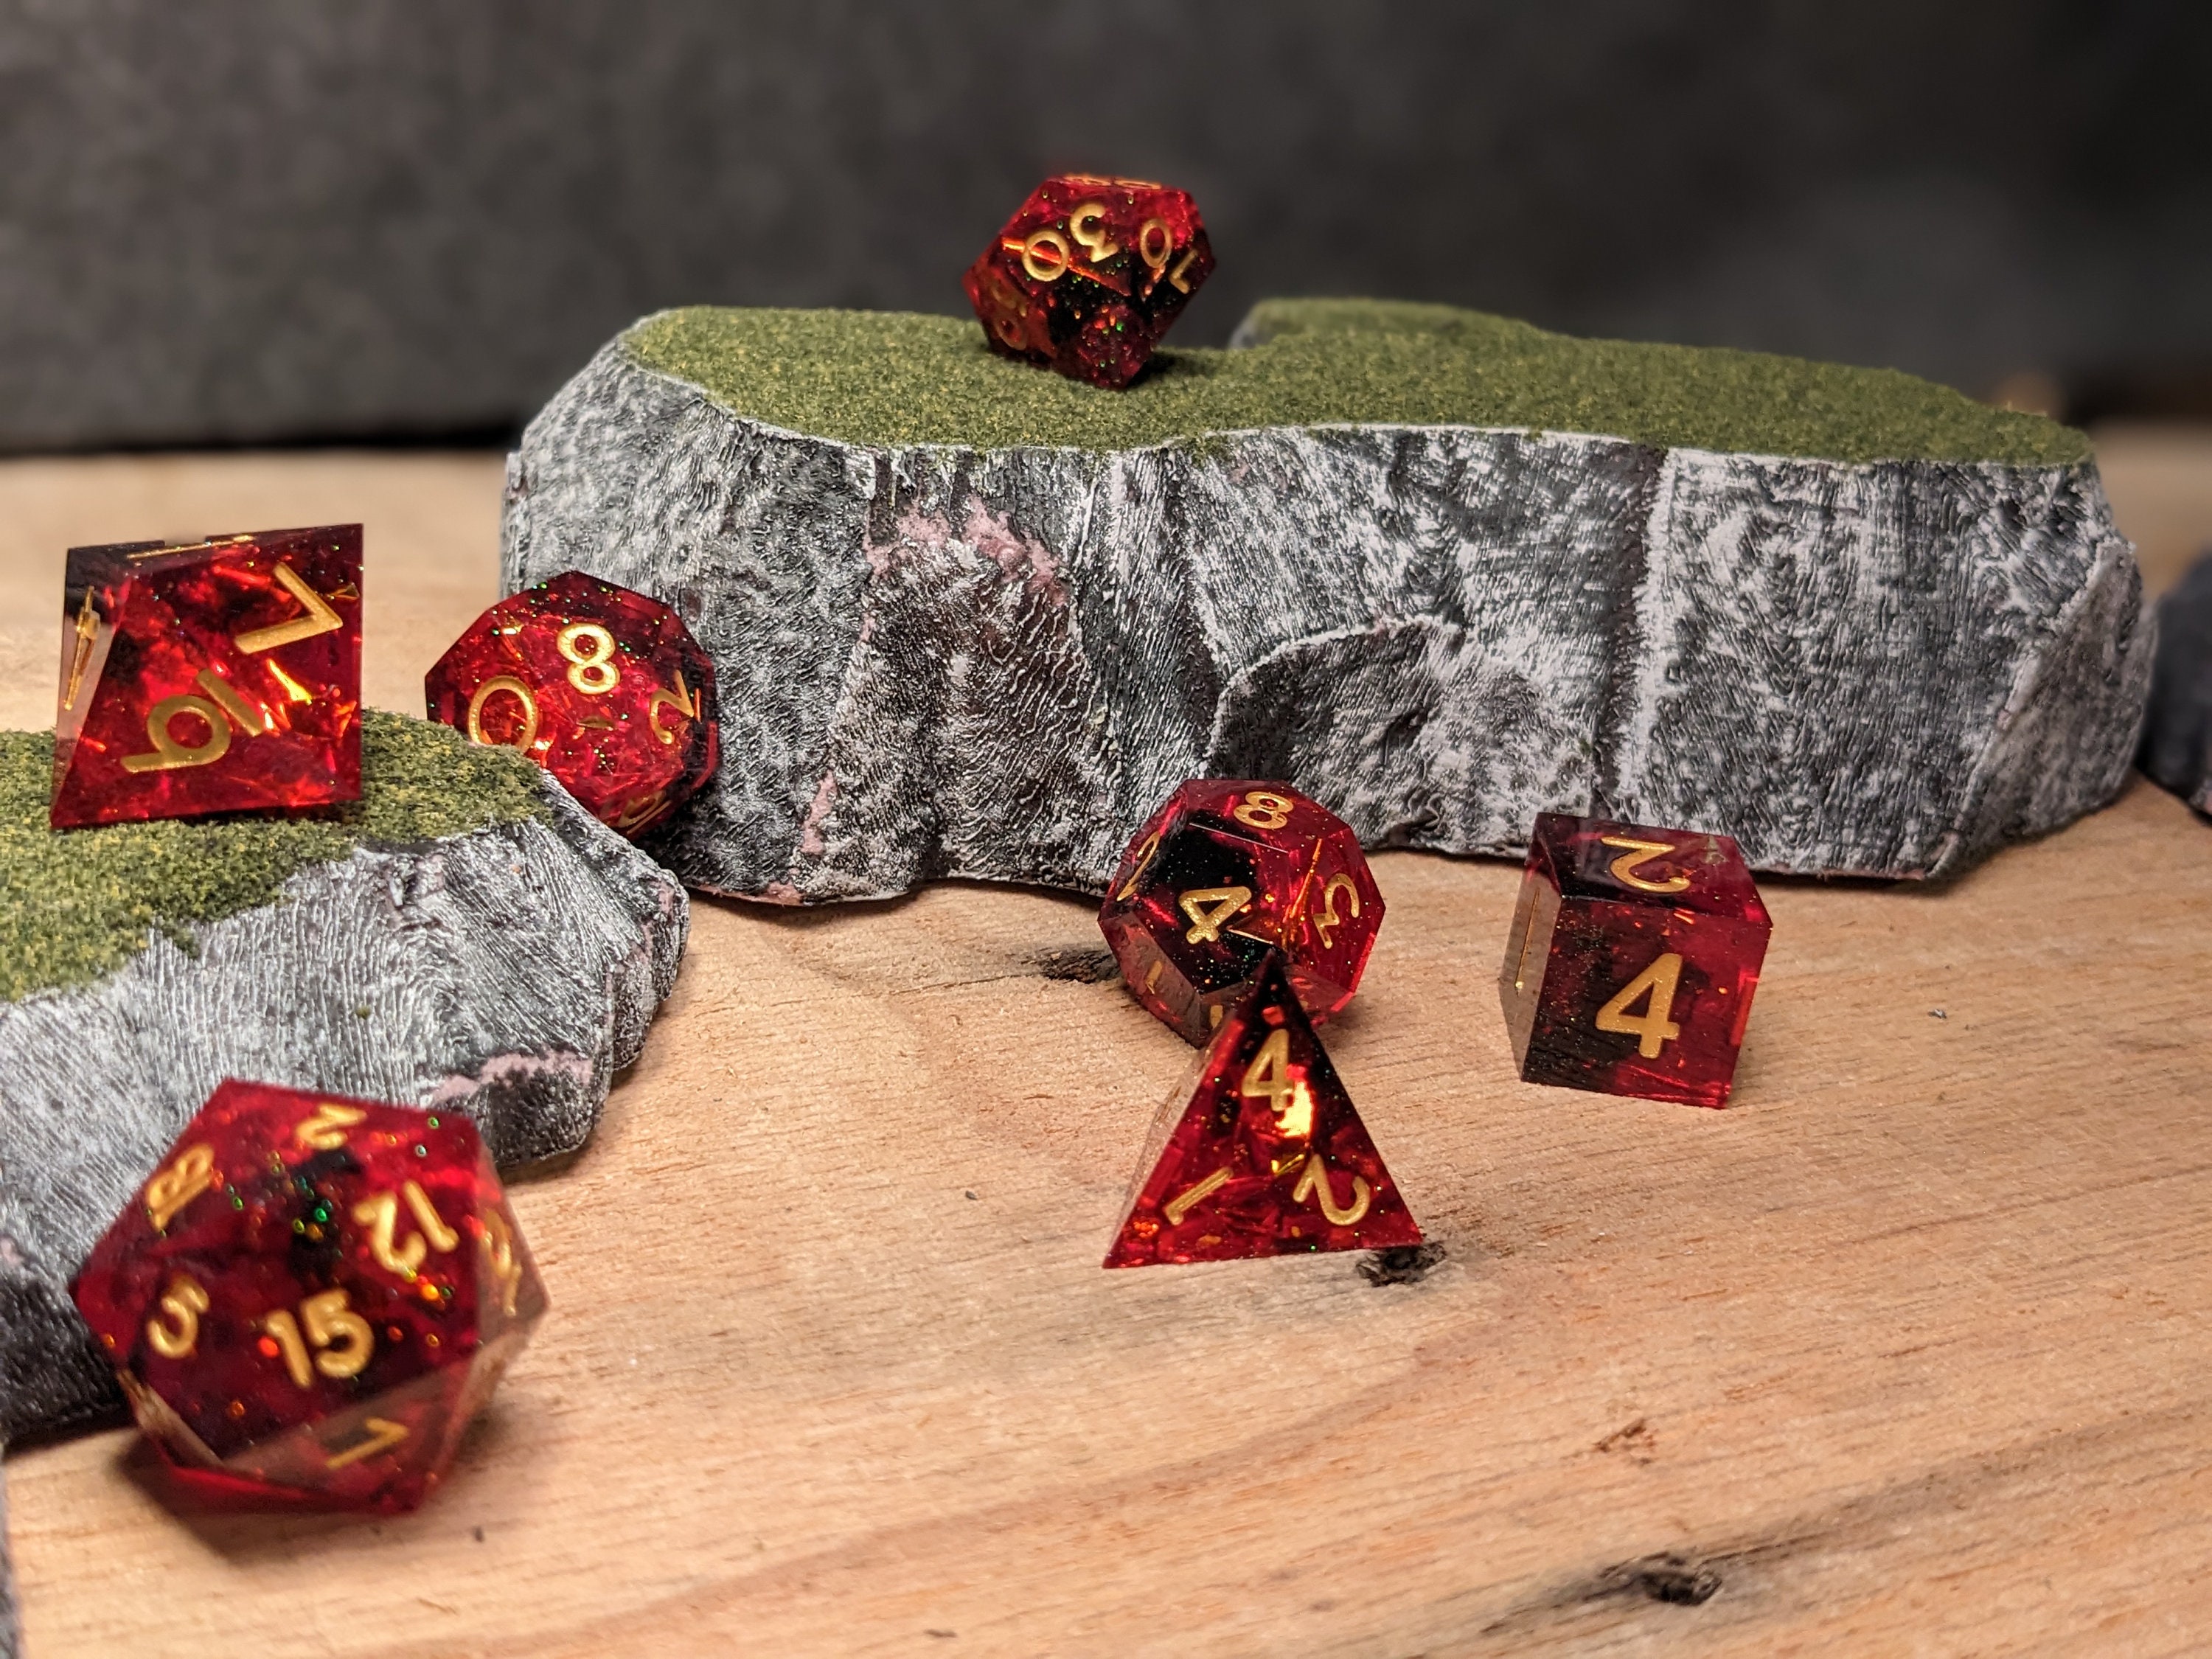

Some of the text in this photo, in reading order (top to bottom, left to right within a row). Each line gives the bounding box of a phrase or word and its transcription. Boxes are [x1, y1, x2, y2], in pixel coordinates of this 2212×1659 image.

[234, 561, 344, 655] 7
[556, 622, 621, 695] 8
[650, 669, 695, 745] 2
[1233, 791, 1294, 830] 8
[1601, 836, 1692, 894] 2
[1179, 886, 1252, 945] 4
[1595, 953, 1683, 1060] 4
[1242, 1028, 1295, 1112] 4
[352, 1180, 459, 1273] 12
[1164, 1167, 1234, 1225] 1
[1293, 1154, 1370, 1226] 2
[266, 1287, 375, 1389] 15
[325, 1416, 409, 1470] 7
